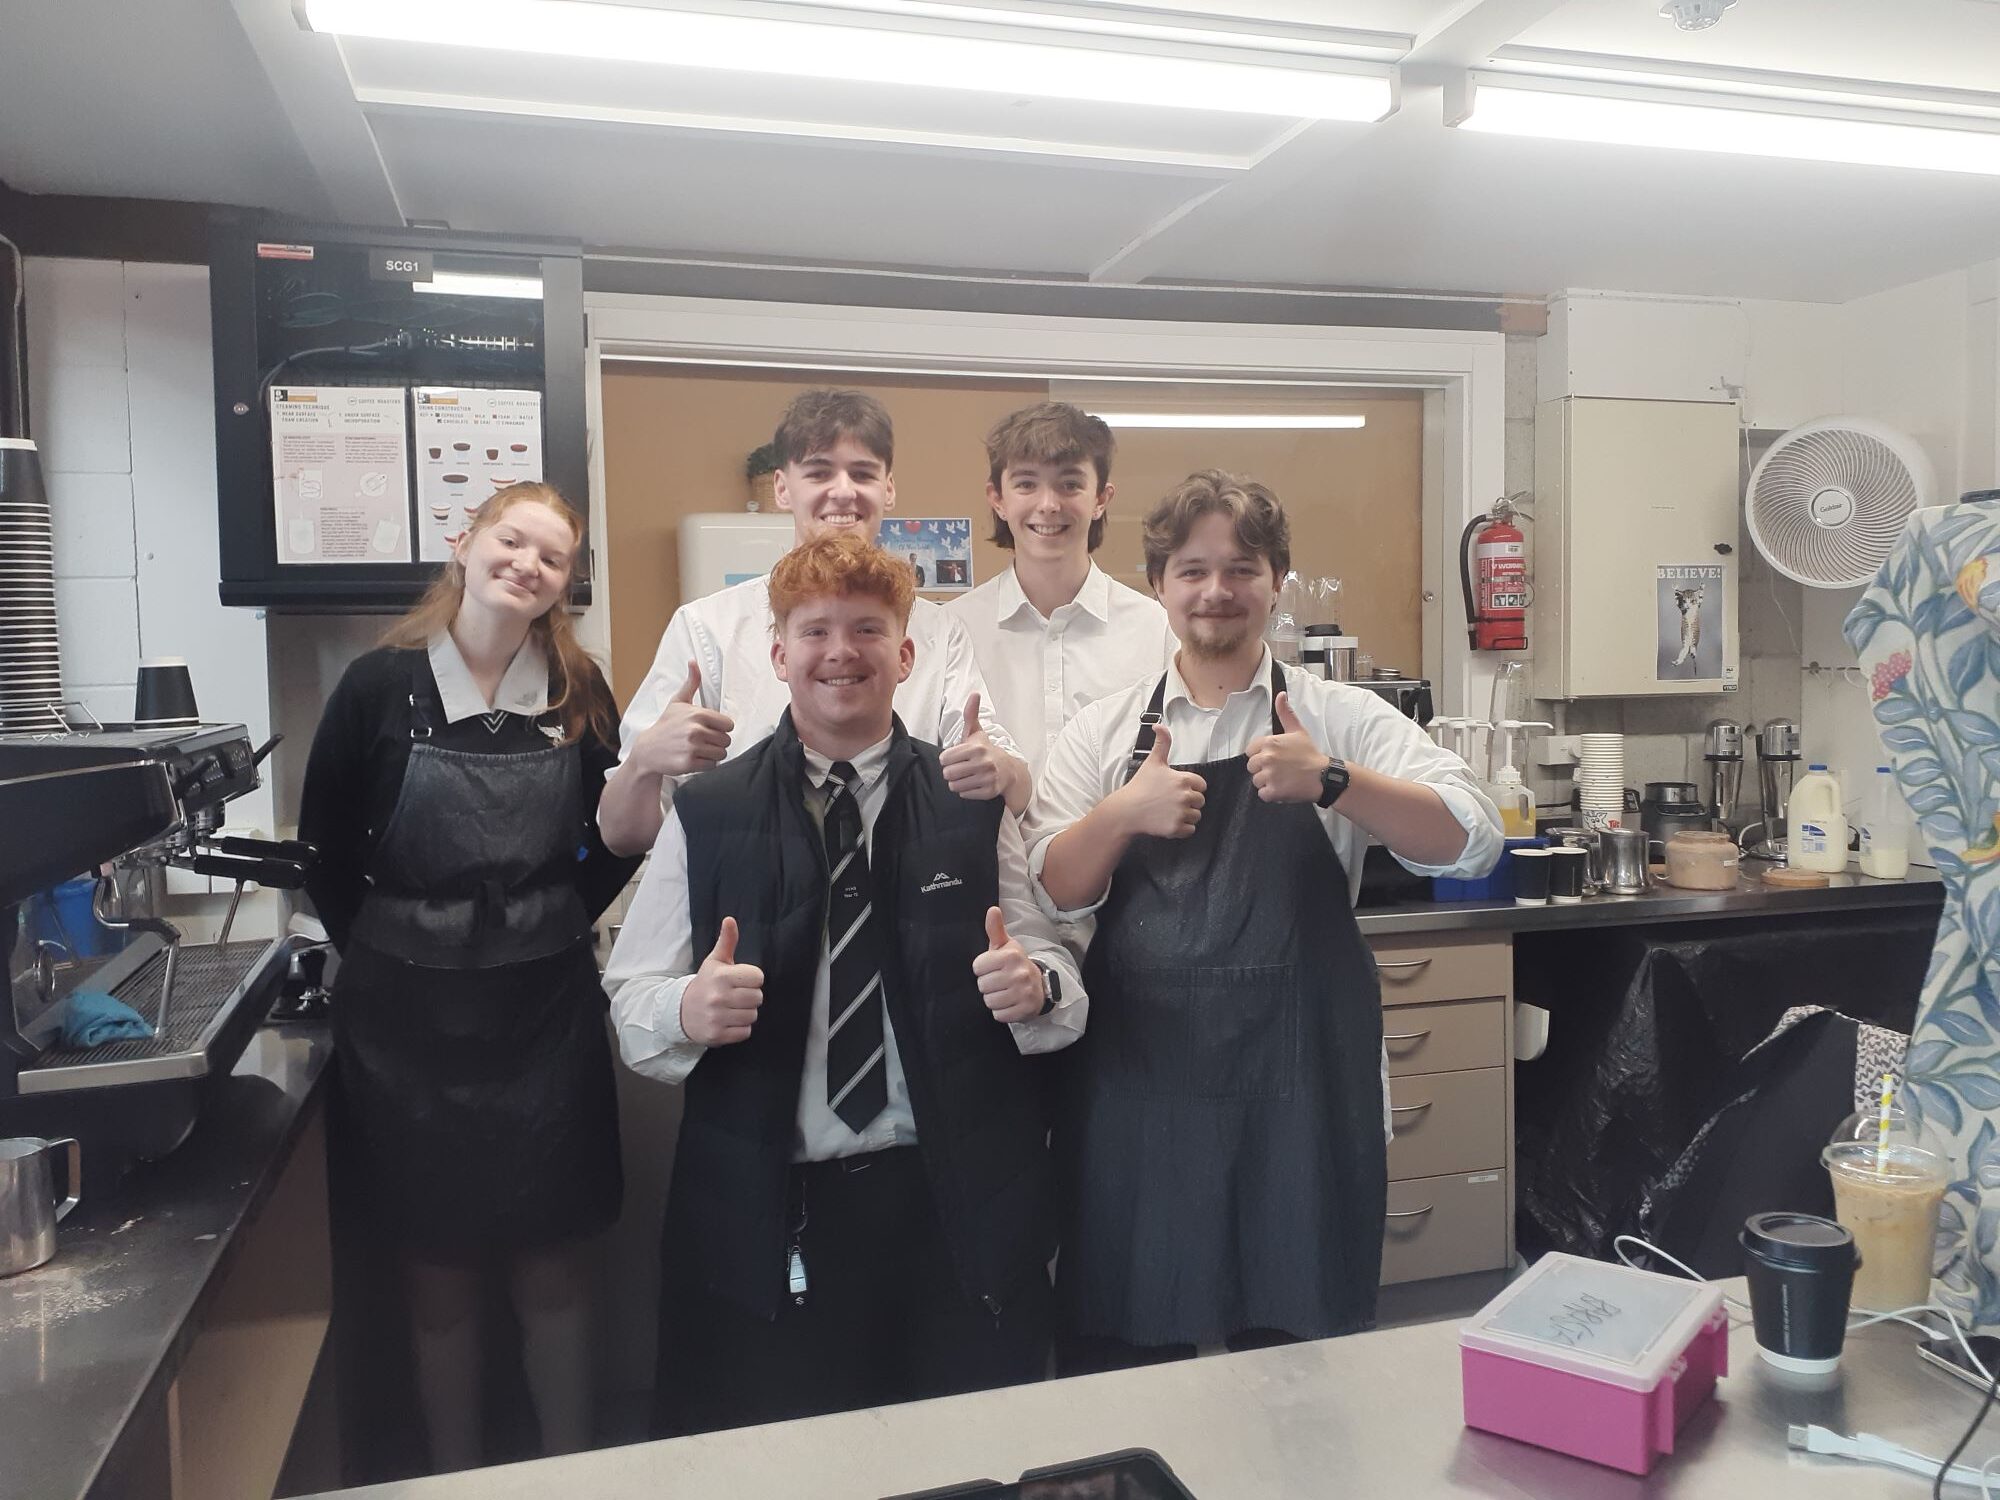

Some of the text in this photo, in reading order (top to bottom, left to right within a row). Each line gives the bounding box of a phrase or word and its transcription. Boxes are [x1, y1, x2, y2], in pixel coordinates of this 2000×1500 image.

[385, 260, 419, 272] SCG1
[1656, 568, 1721, 579] BELIEVE!
[920, 878, 963, 893] Kathmandu
